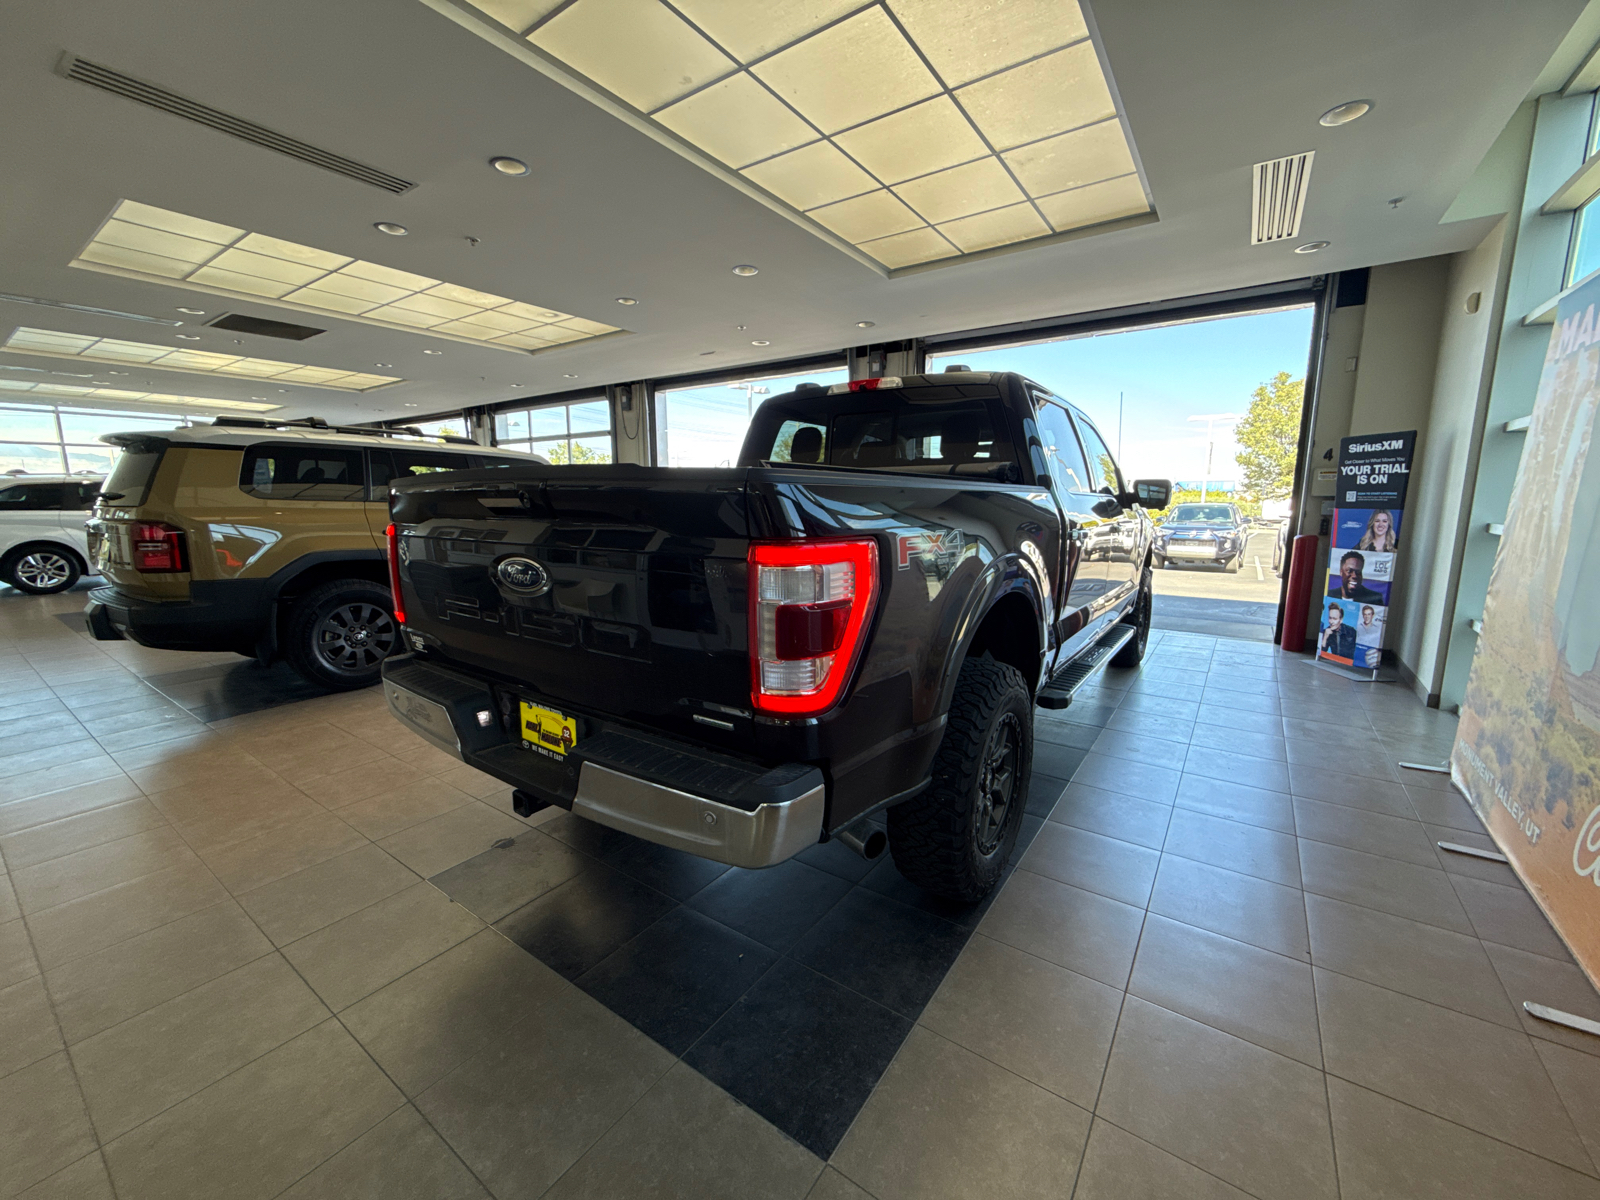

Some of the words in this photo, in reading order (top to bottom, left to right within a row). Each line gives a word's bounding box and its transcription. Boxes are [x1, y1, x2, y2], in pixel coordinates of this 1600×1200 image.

[1555, 302, 1600, 360] MA
[1323, 448, 1333, 461] 4
[1348, 439, 1404, 454] SiriusXM
[1341, 465, 1371, 475] YOUR
[1373, 463, 1409, 474] TRIAL
[1356, 474, 1368, 485] IS
[1370, 474, 1388, 484] ON
[896, 528, 965, 572] FX4
[506, 563, 533, 585] Ford
[436, 590, 653, 665] F-150
[1459, 738, 1494, 787] MONUMENT
[1494, 781, 1525, 831] VALLEY,
[1525, 819, 1541, 843] UT
